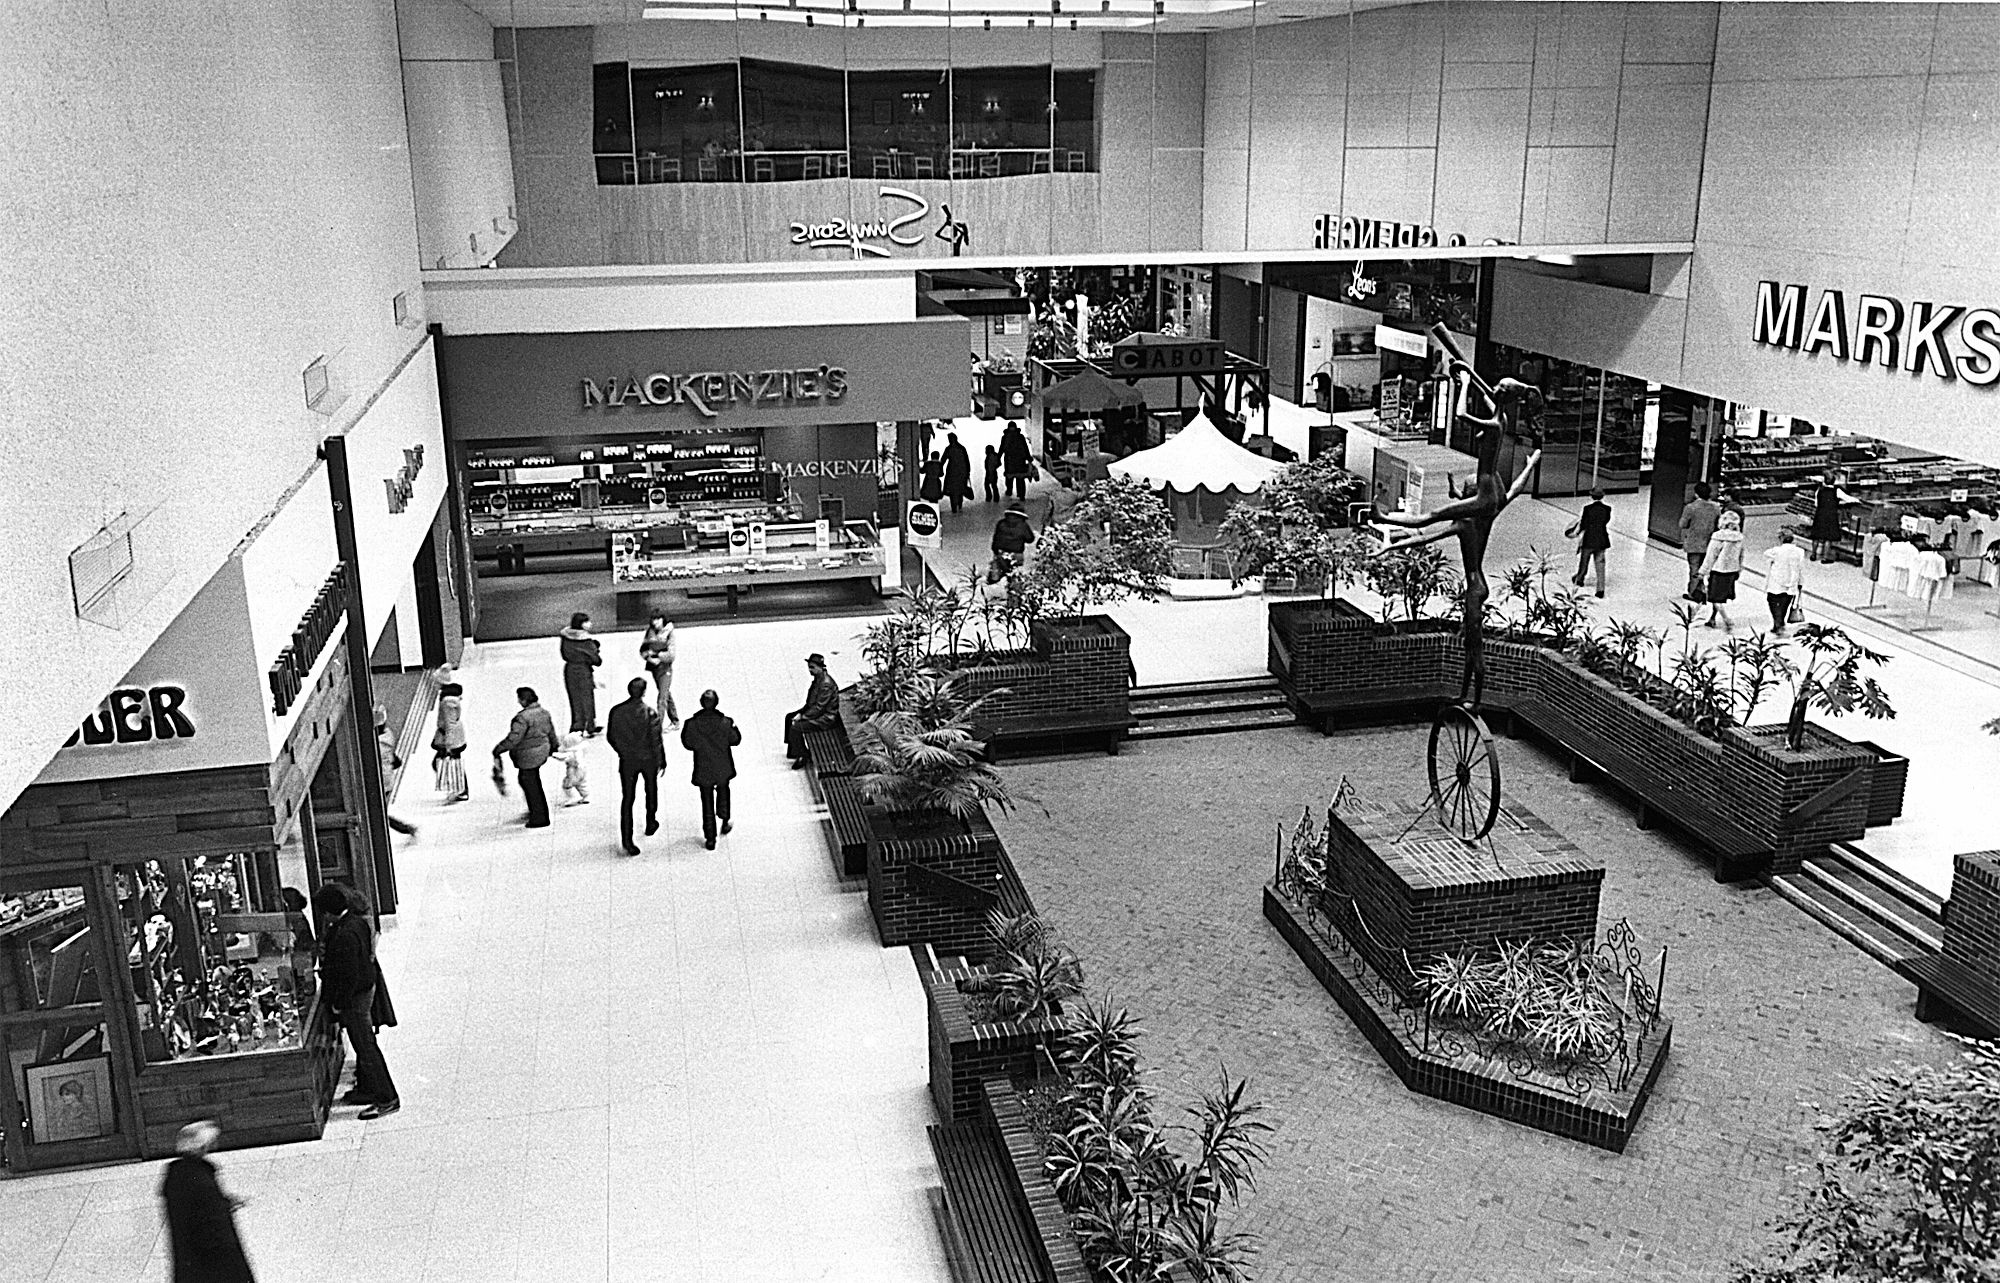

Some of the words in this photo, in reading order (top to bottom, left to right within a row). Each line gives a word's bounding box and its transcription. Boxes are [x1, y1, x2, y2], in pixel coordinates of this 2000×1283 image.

[1119, 346, 1220, 370] CABOT
[1752, 280, 2000, 387] MARKS
[583, 363, 849, 417] MACKENZIE'S
[62, 686, 196, 749] LER
